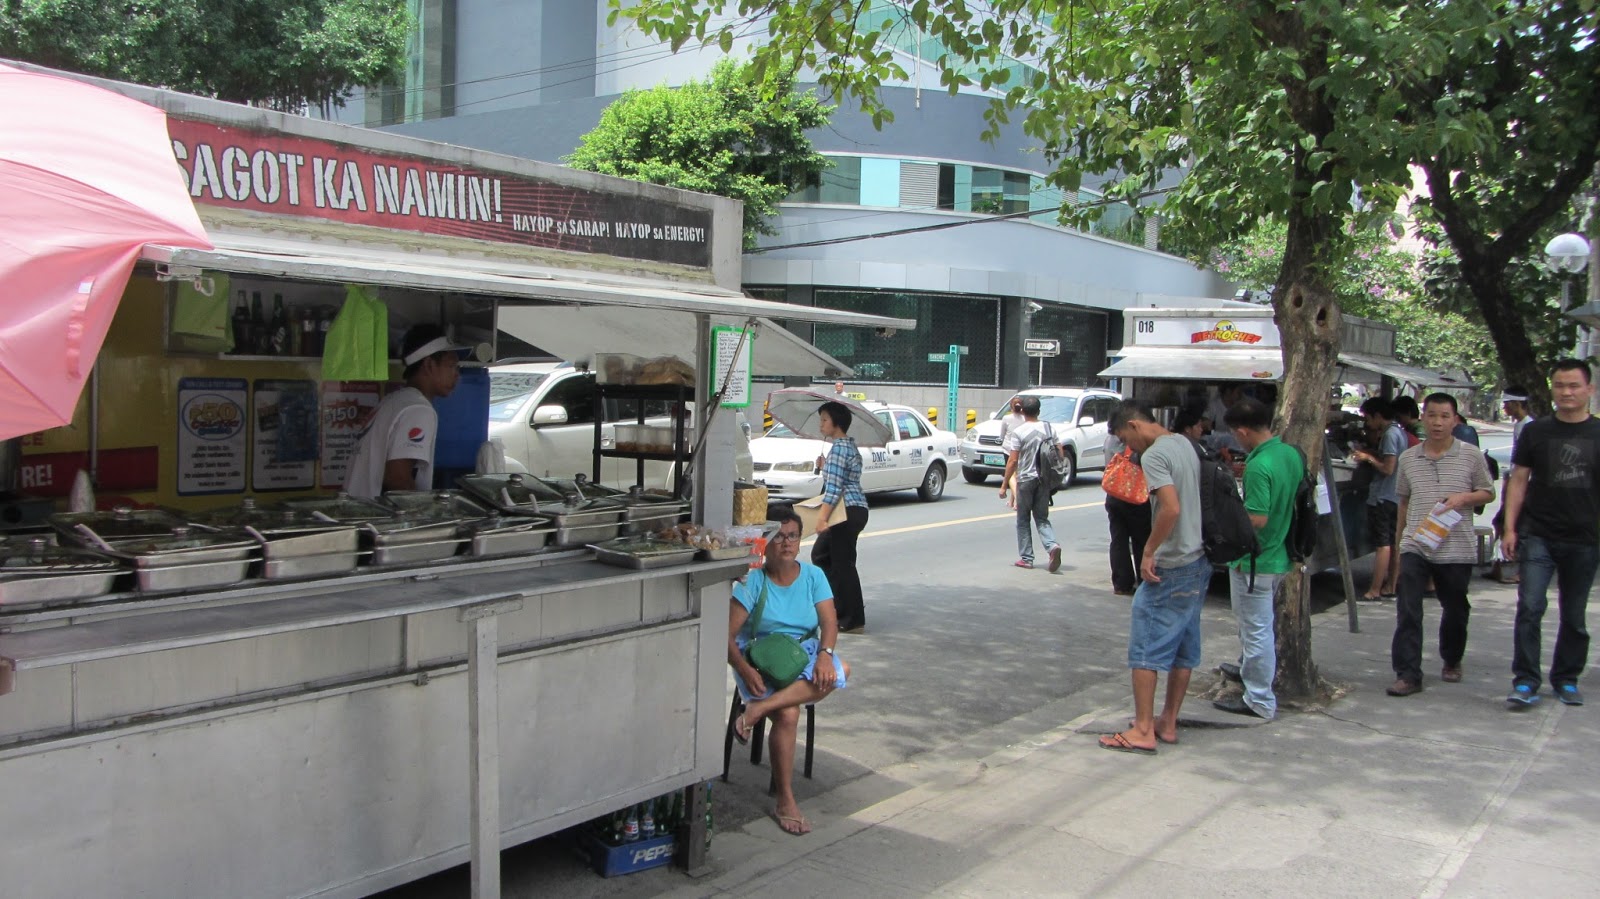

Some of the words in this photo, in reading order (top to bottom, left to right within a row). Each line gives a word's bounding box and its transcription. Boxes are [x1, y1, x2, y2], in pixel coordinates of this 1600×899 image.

[313, 157, 367, 211] KA
[374, 164, 502, 223] NAMIN!
[513, 214, 553, 233] HAYOP
[569, 219, 610, 238] SARAP!
[615, 222, 650, 239] HAYOP
[664, 225, 705, 243] ENERGY!
[1138, 320, 1154, 334] 018
[1190, 329, 1262, 344] METROCHEF
[871, 451, 887, 463] DMC
[632, 844, 673, 864] PEPS
